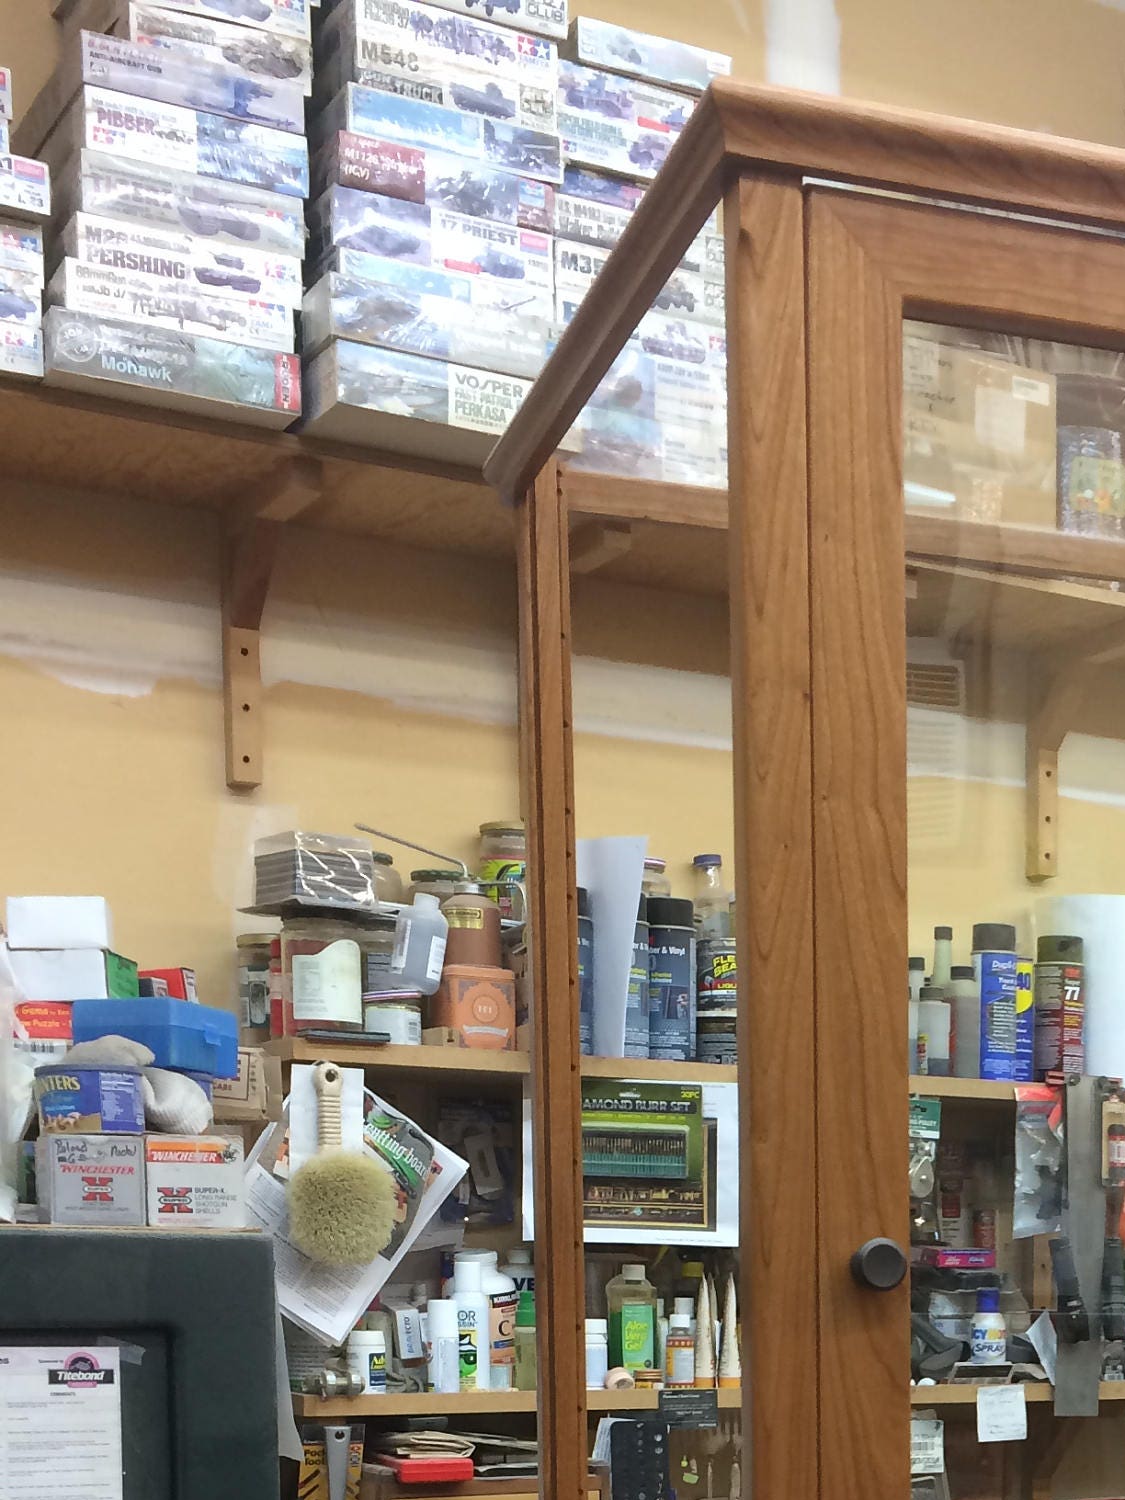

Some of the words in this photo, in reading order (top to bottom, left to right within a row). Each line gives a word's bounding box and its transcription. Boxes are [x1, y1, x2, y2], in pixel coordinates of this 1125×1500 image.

[527, 5, 563, 23] CLUB
[97, 110, 155, 134] PIBBER
[462, 224, 518, 245] PRIEST
[86, 244, 185, 279] PERSHING
[101, 355, 172, 382] Mohawk
[455, 372, 523, 398] VOSPER
[455, 400, 506, 423] PERKASA
[669, 946, 685, 956] Vinyl
[1064, 986, 1080, 1000] 77
[33, 1020, 60, 1028] Puzzle
[636, 1100, 667, 1111] BURR
[670, 1102, 691, 1112] SET
[365, 1122, 405, 1160] cutting
[151, 1151, 217, 1163] WINCHETER
[60, 1165, 135, 1175] WINCHESTER
[498, 1320, 511, 1336] C
[625, 1321, 649, 1331] Aloe
[974, 1343, 1003, 1354] SPRAY
[57, 1371, 105, 1381] Titebond
